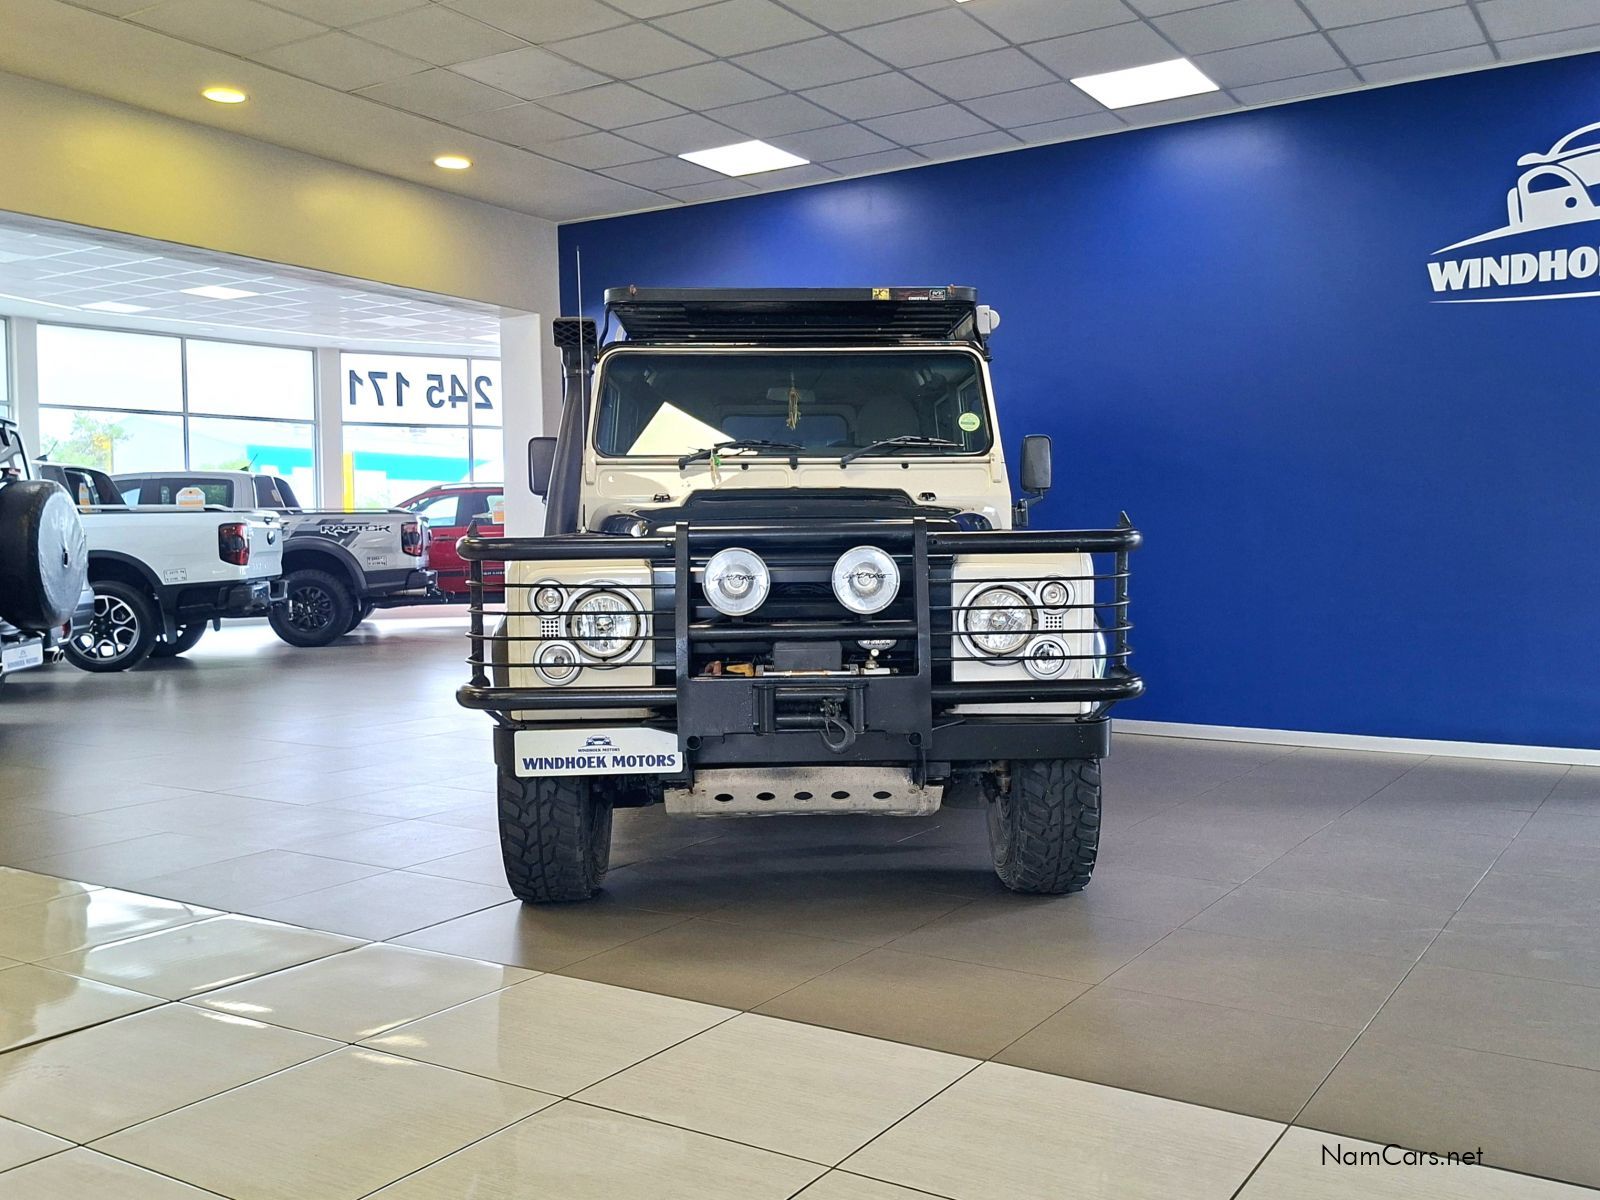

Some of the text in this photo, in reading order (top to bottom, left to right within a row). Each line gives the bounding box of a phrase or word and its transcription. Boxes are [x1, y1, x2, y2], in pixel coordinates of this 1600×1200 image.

[1427, 246, 1600, 292] WINDHO
[320, 524, 392, 537] RAPTOR
[523, 754, 676, 770] WINDHOEK MOTORS
